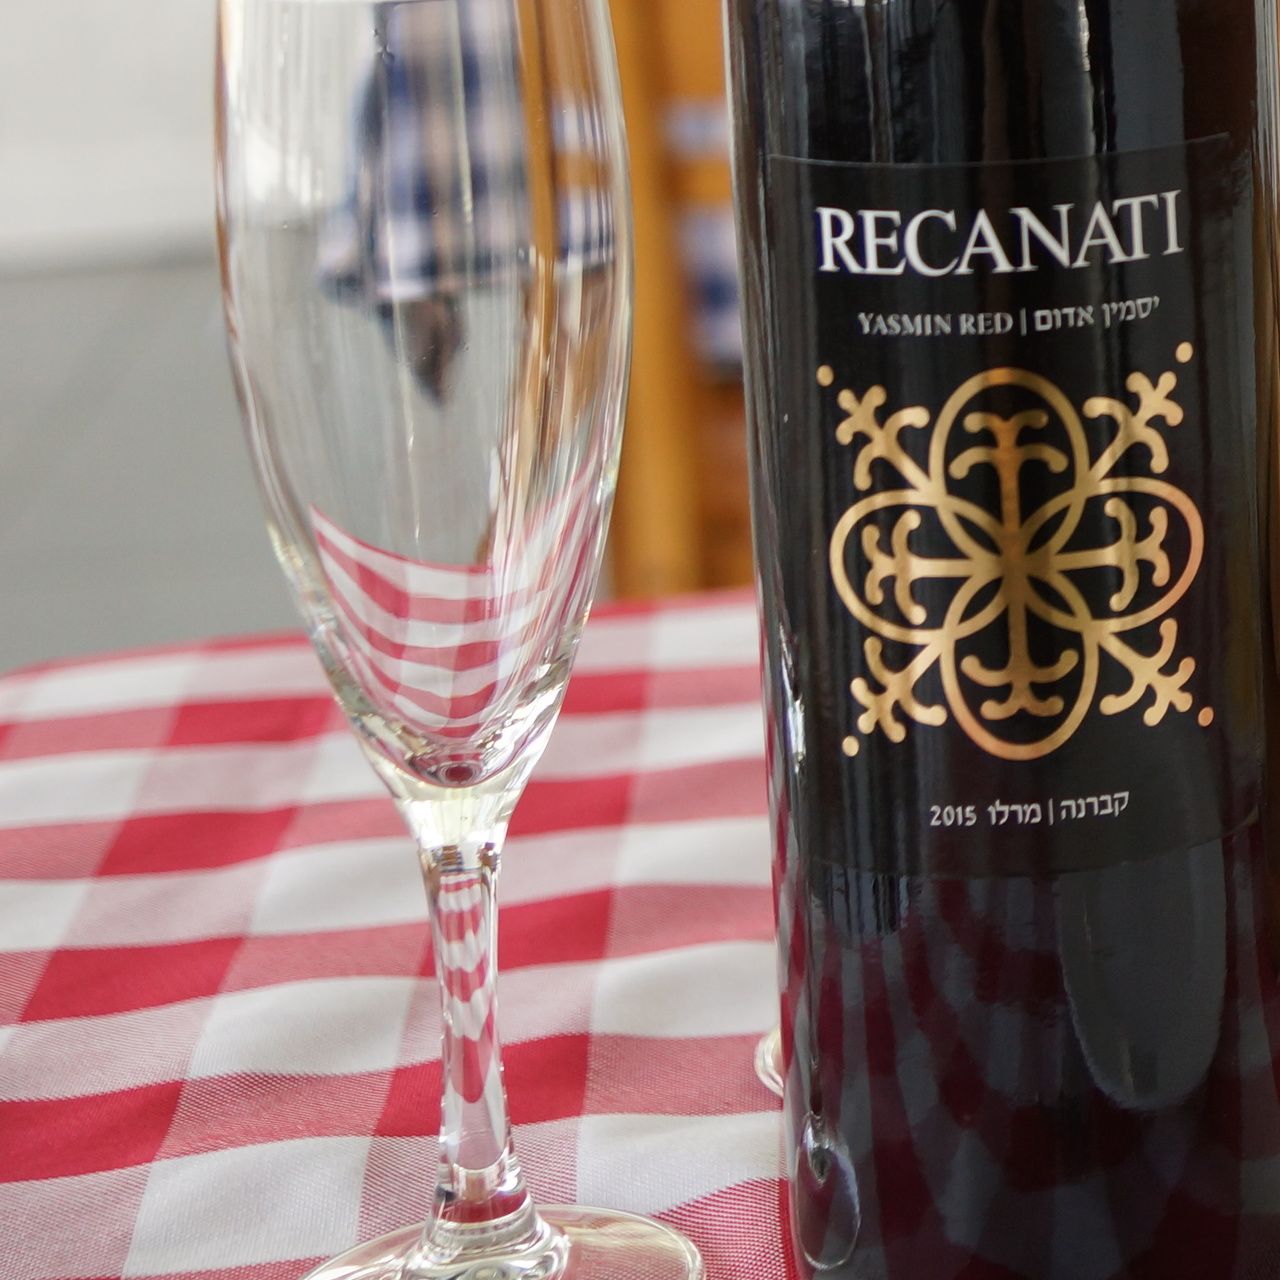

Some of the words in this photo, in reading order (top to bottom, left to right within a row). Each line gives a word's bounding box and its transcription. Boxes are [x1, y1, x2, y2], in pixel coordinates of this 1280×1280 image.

[815, 189, 1184, 278] RECANATI
[857, 311, 953, 337] YASMIN
[959, 312, 1014, 336] RED
[1033, 305, 1095, 332] אדום
[1102, 295, 1161, 328] יסמין
[929, 804, 978, 827] 2015
[987, 798, 1043, 826] מרלו
[1059, 790, 1131, 820] קברנה
